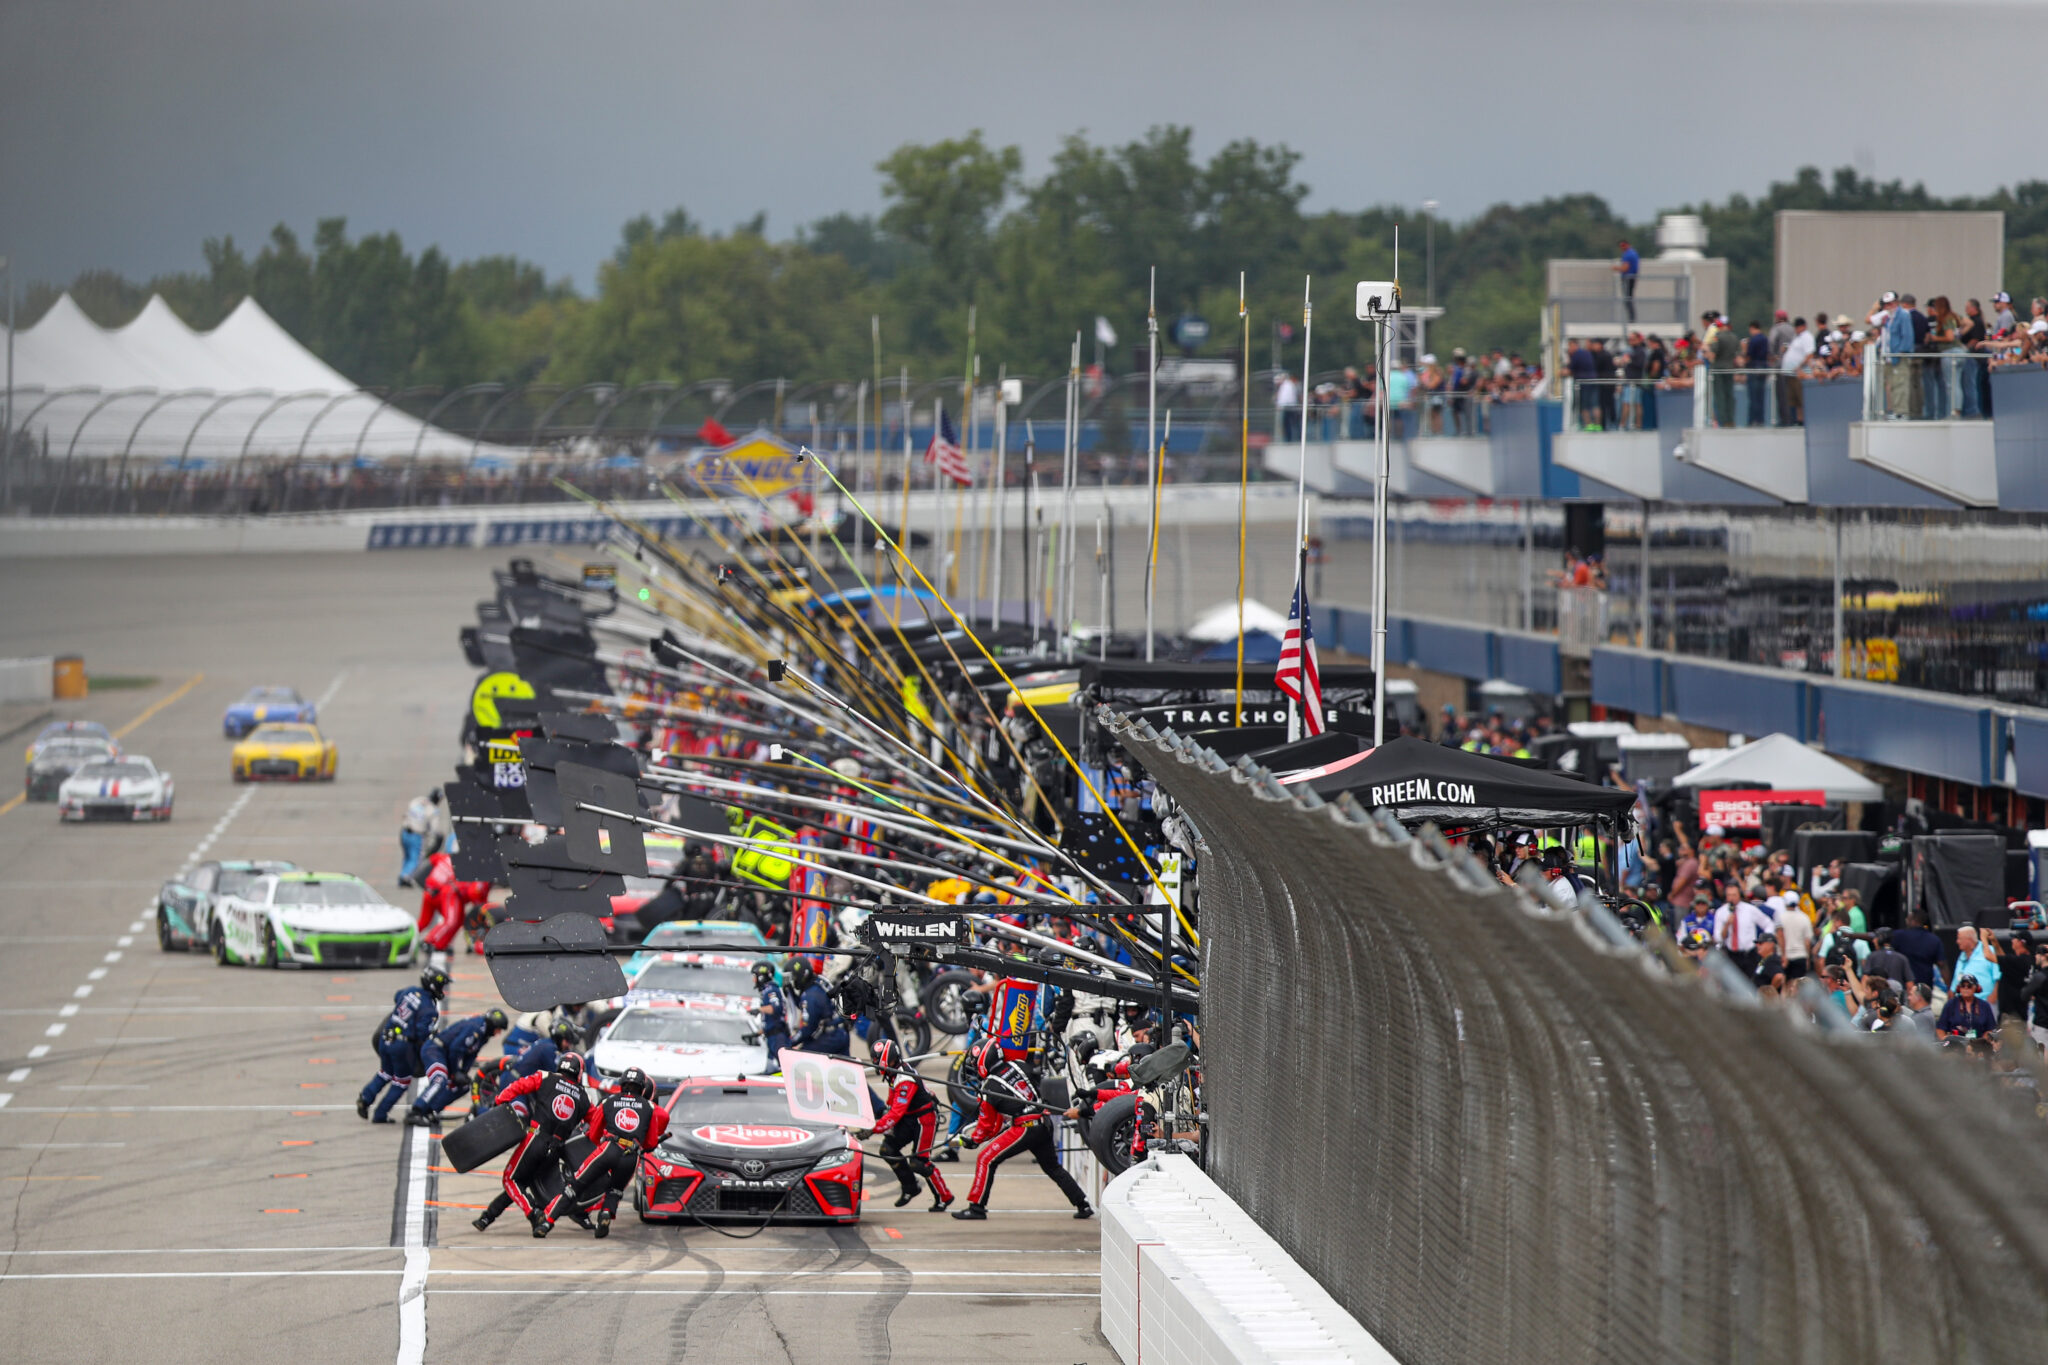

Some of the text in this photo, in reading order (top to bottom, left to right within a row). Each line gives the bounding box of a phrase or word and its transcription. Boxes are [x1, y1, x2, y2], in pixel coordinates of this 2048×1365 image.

[1164, 710, 1338, 723] TRACKHOE
[1371, 778, 1476, 806] RHEEM.COM
[874, 920, 957, 937] WHELEN
[1013, 996, 1028, 1044] SUNOCO
[709, 1124, 806, 1141] Rheem
[721, 1179, 789, 1188] CAMRY
